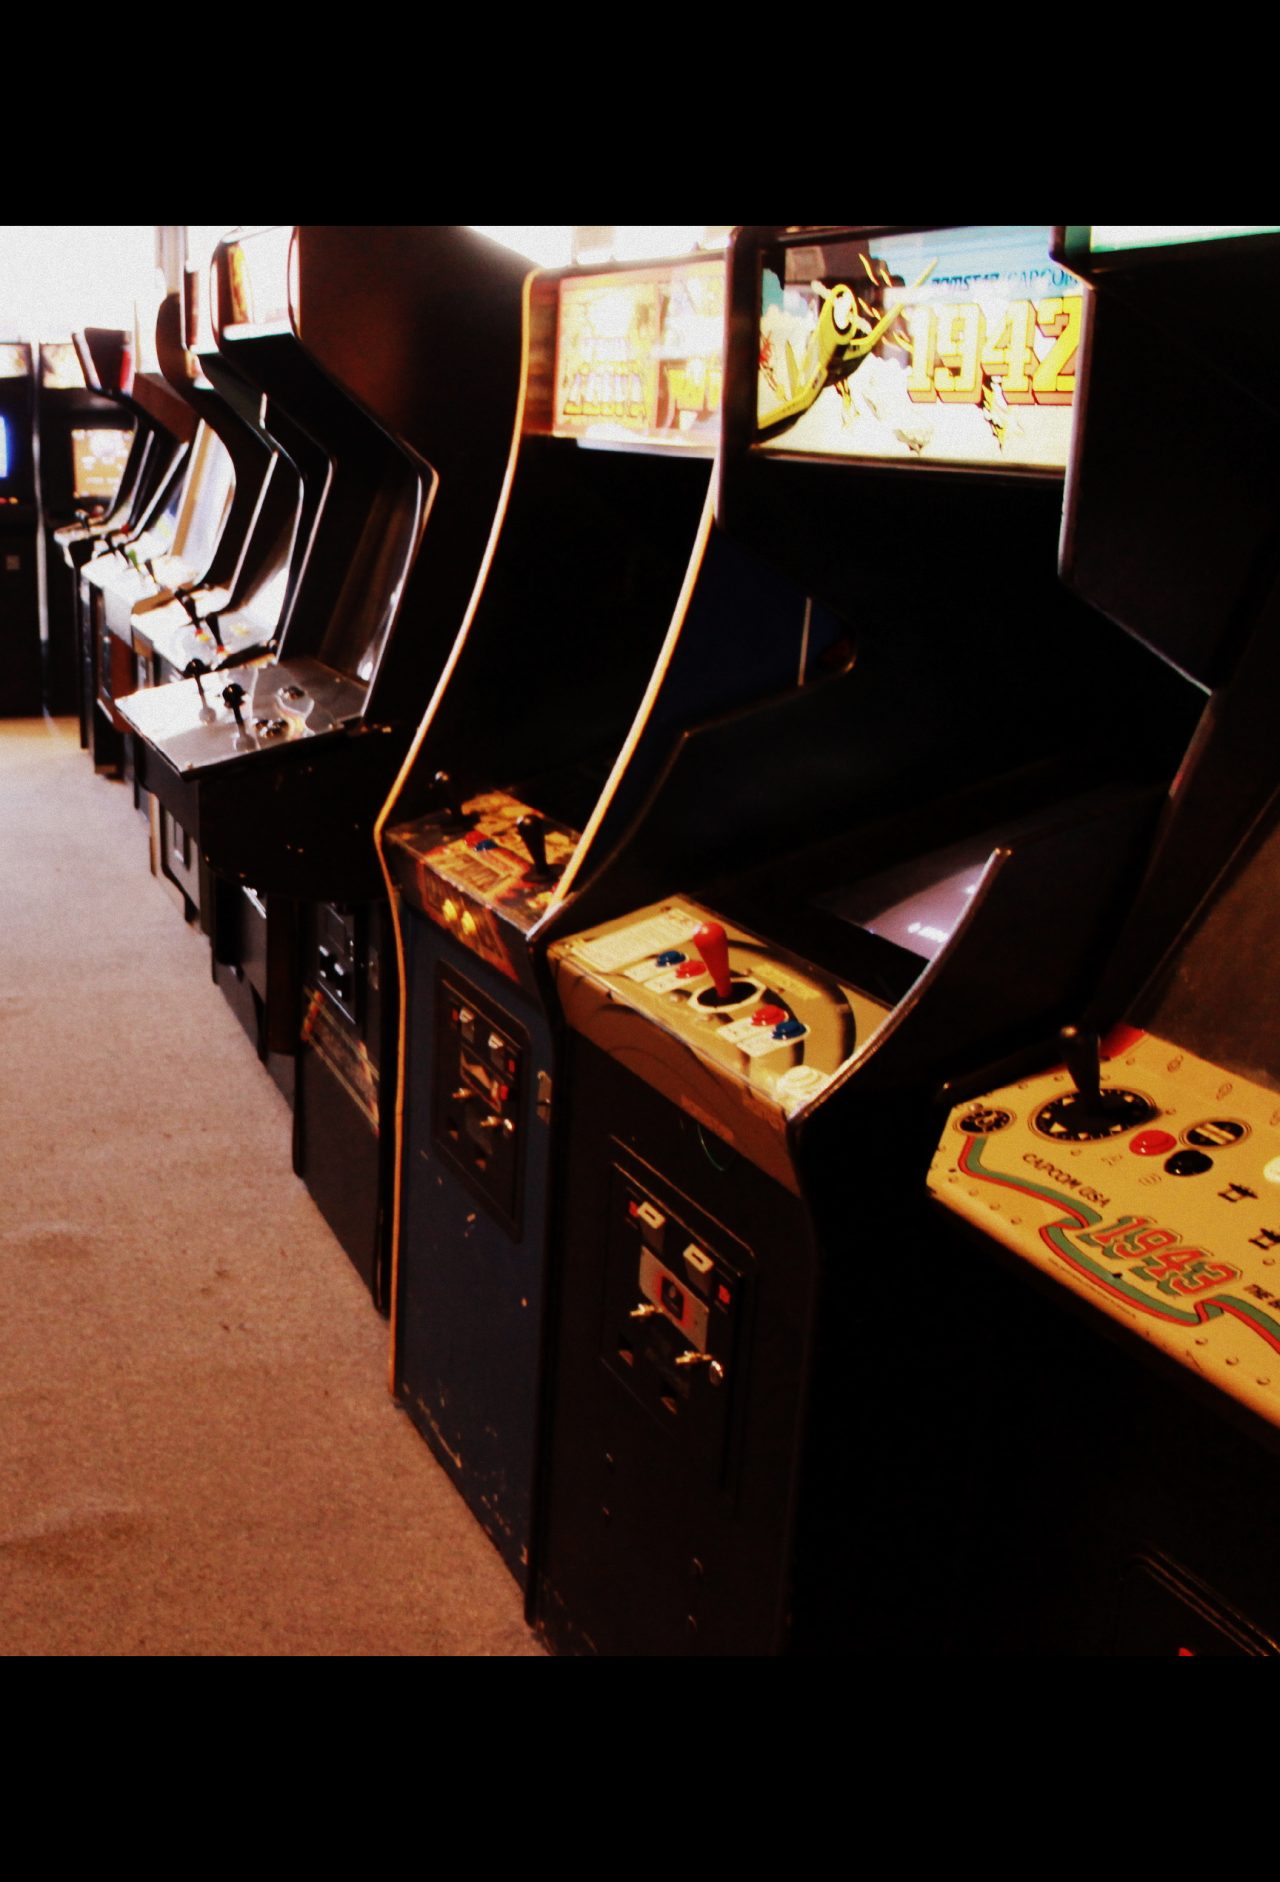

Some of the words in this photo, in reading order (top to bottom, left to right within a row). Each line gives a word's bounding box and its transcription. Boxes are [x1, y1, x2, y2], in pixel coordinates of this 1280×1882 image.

[907, 295, 1084, 406] 1942
[1022, 1153, 1082, 1190] CAPCOM
[1078, 1187, 1111, 1208] USA
[1077, 1215, 1244, 1297] 1943
